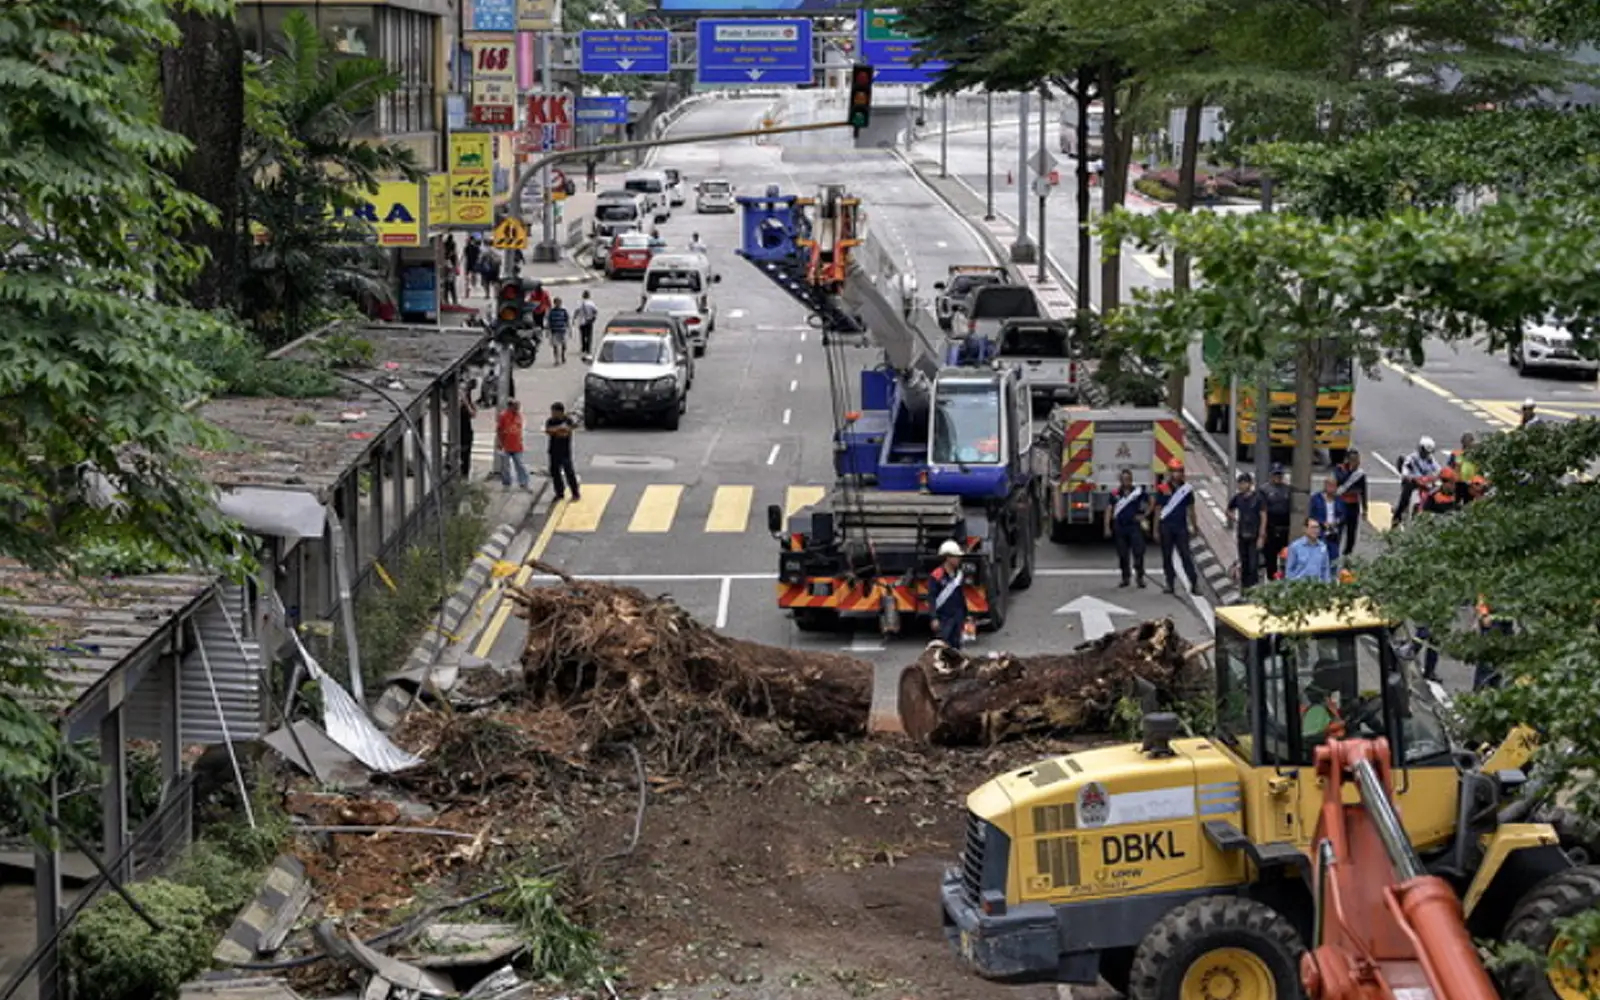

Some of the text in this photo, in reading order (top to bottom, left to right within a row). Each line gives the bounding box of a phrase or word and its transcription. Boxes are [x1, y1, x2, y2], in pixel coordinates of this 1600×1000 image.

[478, 47, 510, 70] 168
[527, 94, 569, 124] KK
[1102, 830, 1186, 866] DBKL
